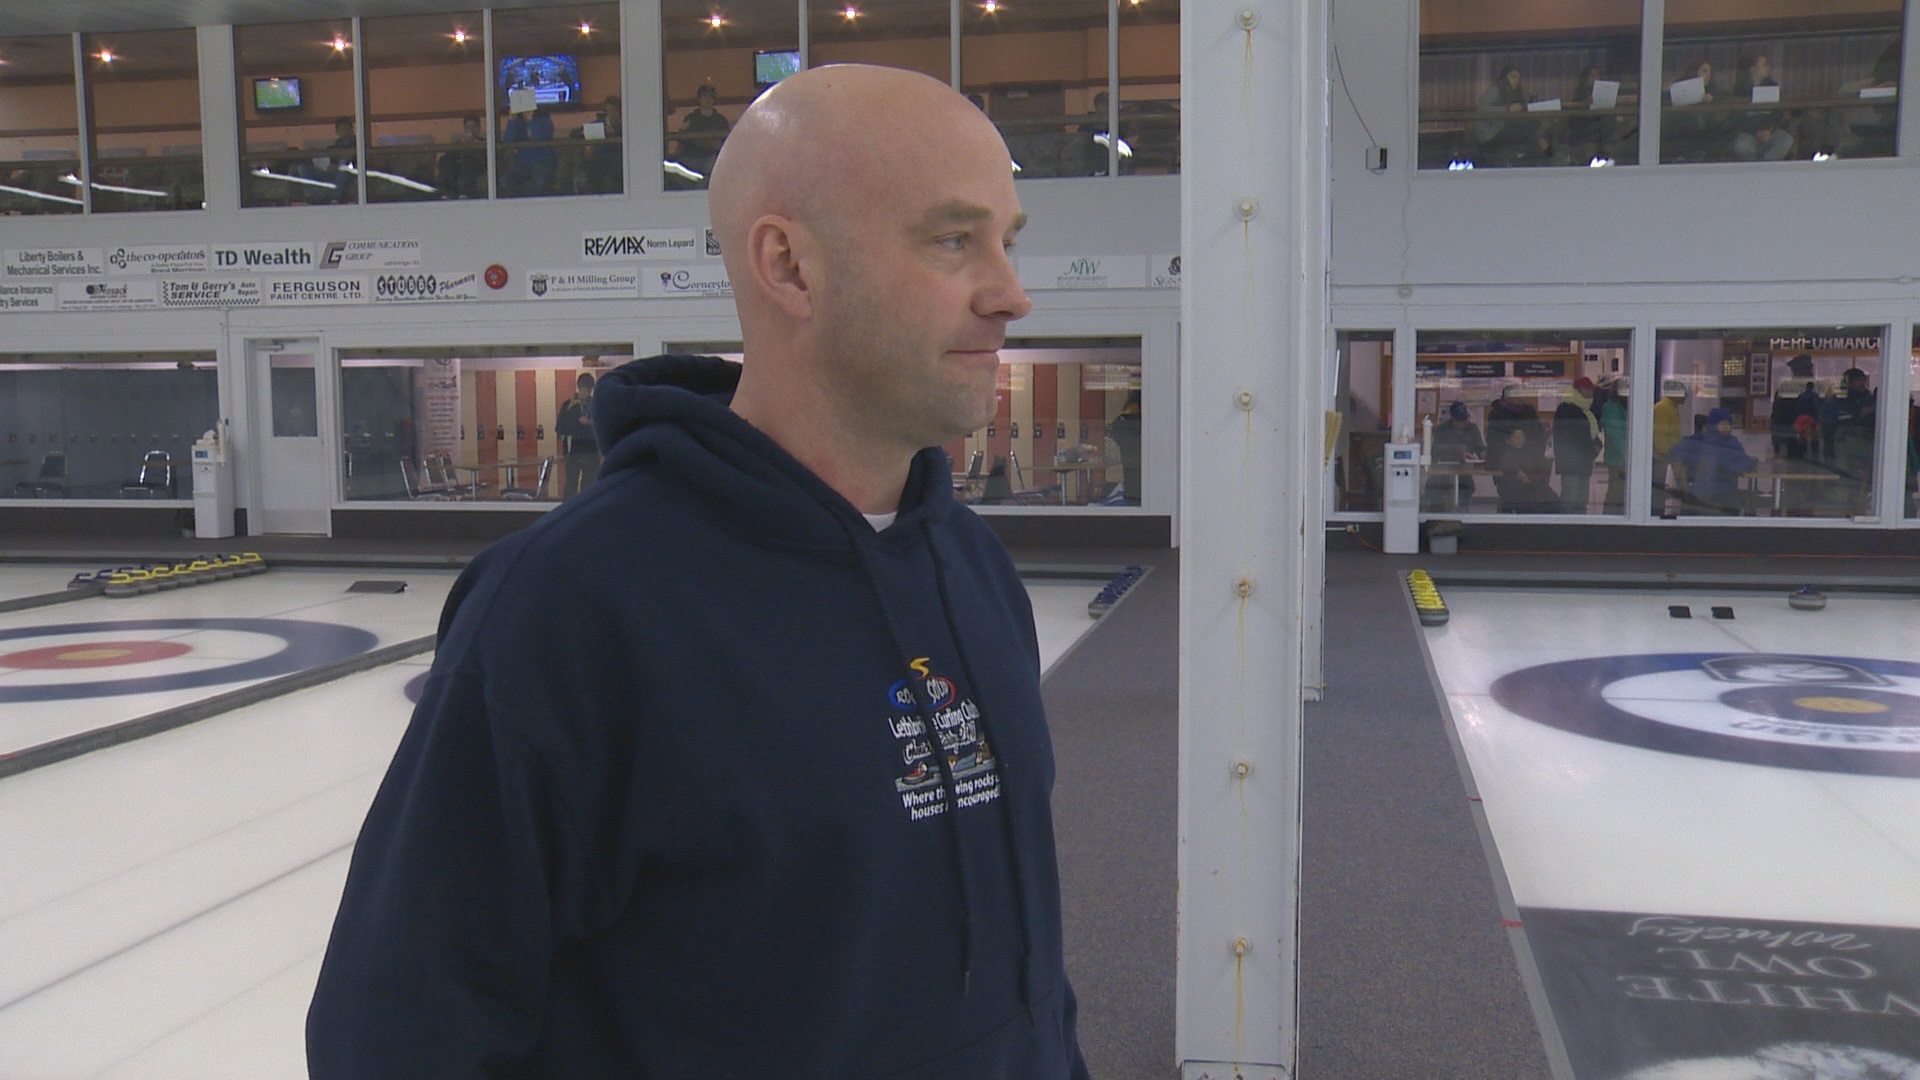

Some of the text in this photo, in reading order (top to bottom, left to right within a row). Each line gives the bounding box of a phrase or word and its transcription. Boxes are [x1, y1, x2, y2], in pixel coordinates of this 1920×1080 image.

[348, 240, 419, 249] COMMUNICATIONS
[585, 235, 645, 256] RE/MAX
[647, 239, 666, 248] Norm
[668, 238, 695, 249] Lepard
[19, 250, 84, 263] Liberty Boilers &
[126, 249, 206, 263] the co-operators
[215, 248, 311, 266] TD Wealth
[345, 253, 373, 261] GROUP
[7, 262, 102, 275] Mechanical Services Inc.
[377, 276, 437, 295] STUBBS
[439, 273, 475, 293] Pharmacy
[551, 273, 636, 286] P & H Milling Group
[20, 286, 53, 295] Insurance
[170, 281, 236, 292] Tom & Gerry's
[237, 288, 258, 296] Repair
[273, 281, 361, 293] FERGUSON
[171, 291, 220, 299] SERVICE
[11, 298, 38, 307] Services
[902, 791, 934, 809] Where
[974, 773, 994, 787] rocks
[911, 804, 943, 821] houses
[1627, 916, 1872, 950] Whisky
[1656, 948, 1877, 980] OWL
